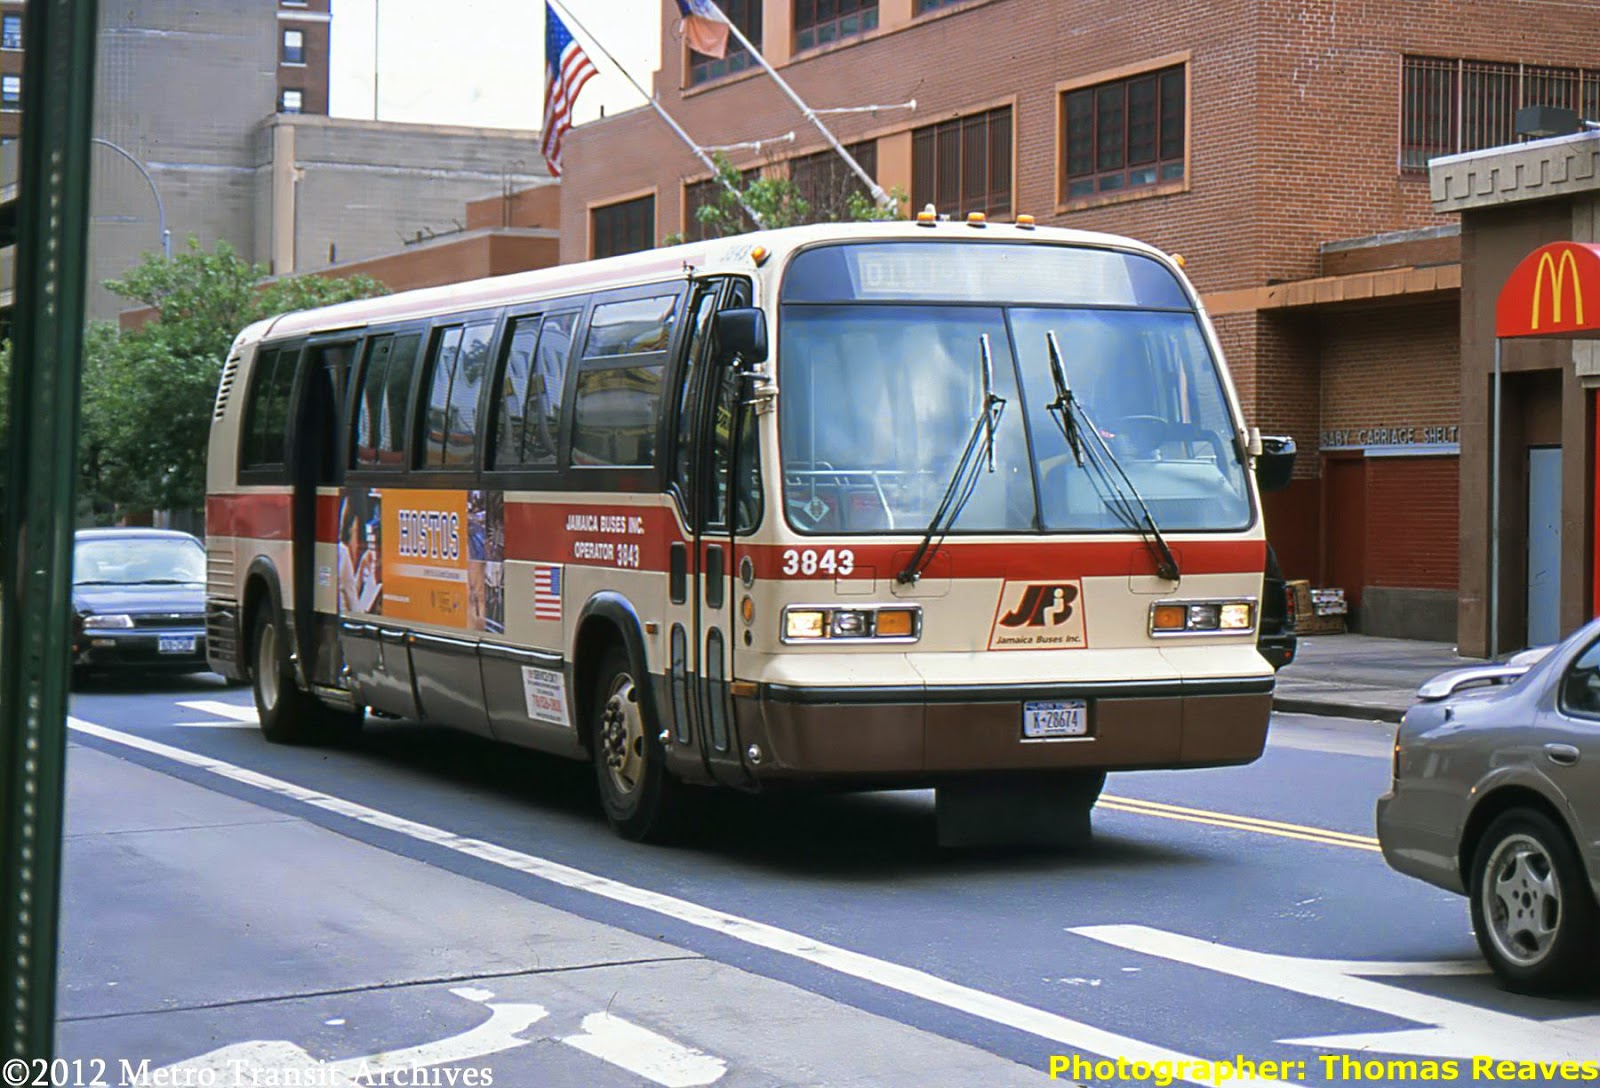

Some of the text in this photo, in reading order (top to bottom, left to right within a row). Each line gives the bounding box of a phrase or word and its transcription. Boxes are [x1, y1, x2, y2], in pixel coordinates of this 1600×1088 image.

[1322, 430, 1349, 447] BABY
[1359, 428, 1415, 445] CARRIAGE
[398, 509, 459, 560] HOSTOS
[566, 514, 645, 535] JAMAICA BUSES INC.
[574, 541, 640, 568] OPERATOR 3843
[782, 549, 855, 576] 3843
[996, 635, 1082, 645] Jamaica Buses Inc.
